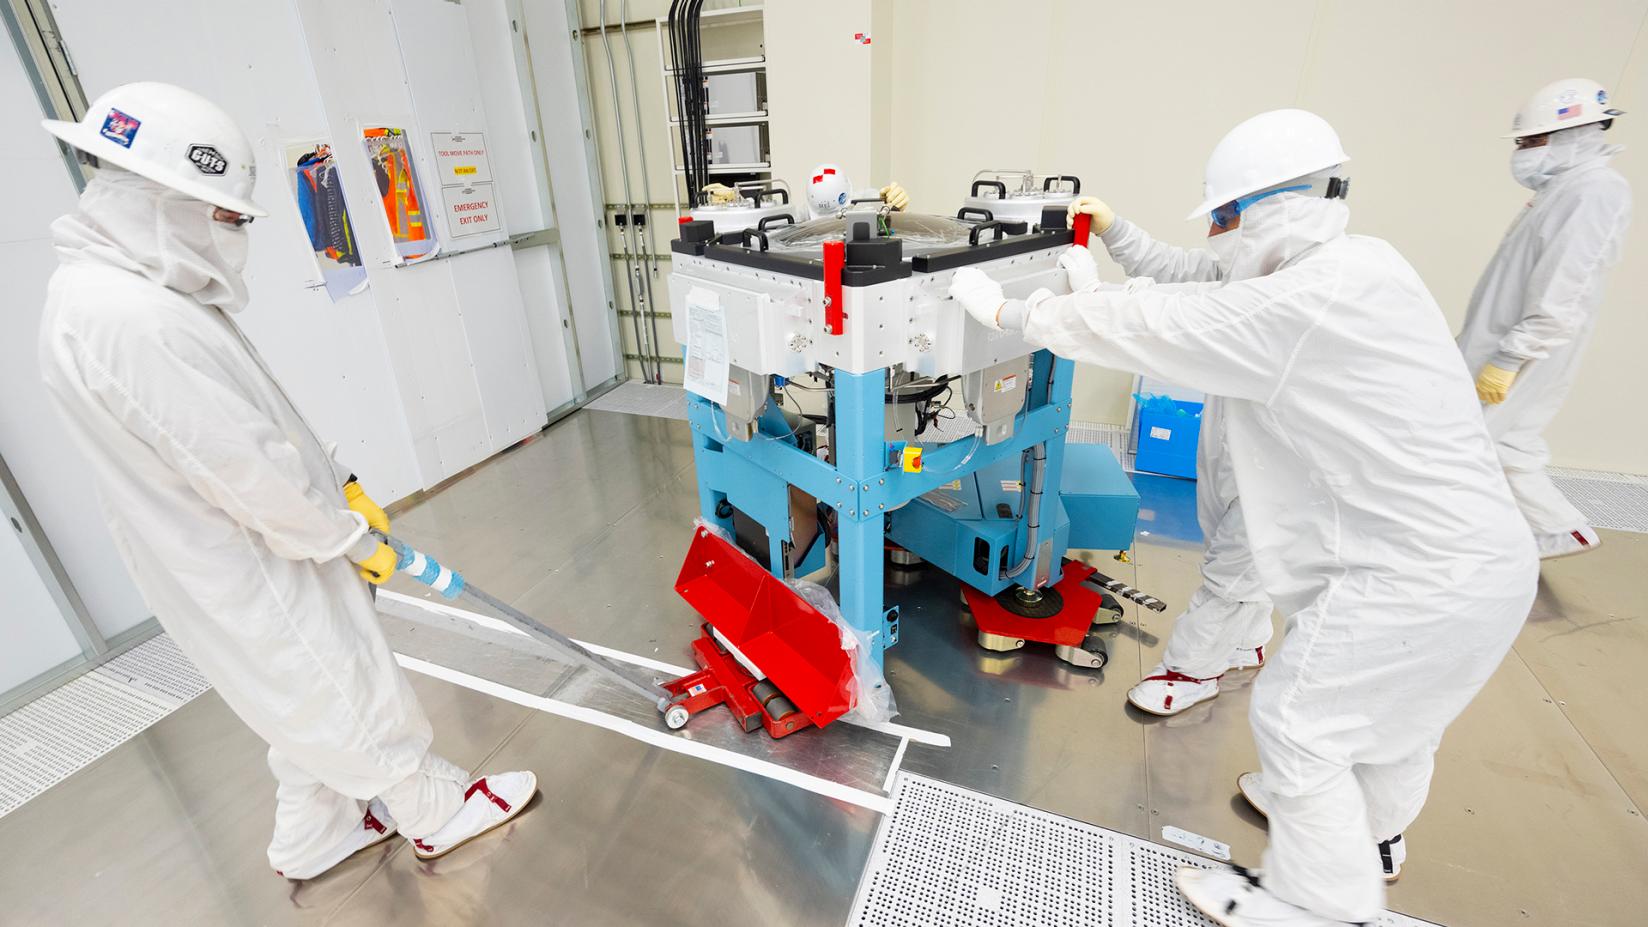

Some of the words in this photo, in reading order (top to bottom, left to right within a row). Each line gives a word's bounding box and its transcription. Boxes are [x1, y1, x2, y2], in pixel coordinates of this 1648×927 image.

[191, 149, 225, 171] GUTS
[453, 201, 488, 212] EMERGENCY
[459, 216, 472, 224] EXIT
[473, 214, 488, 223] ONLY
